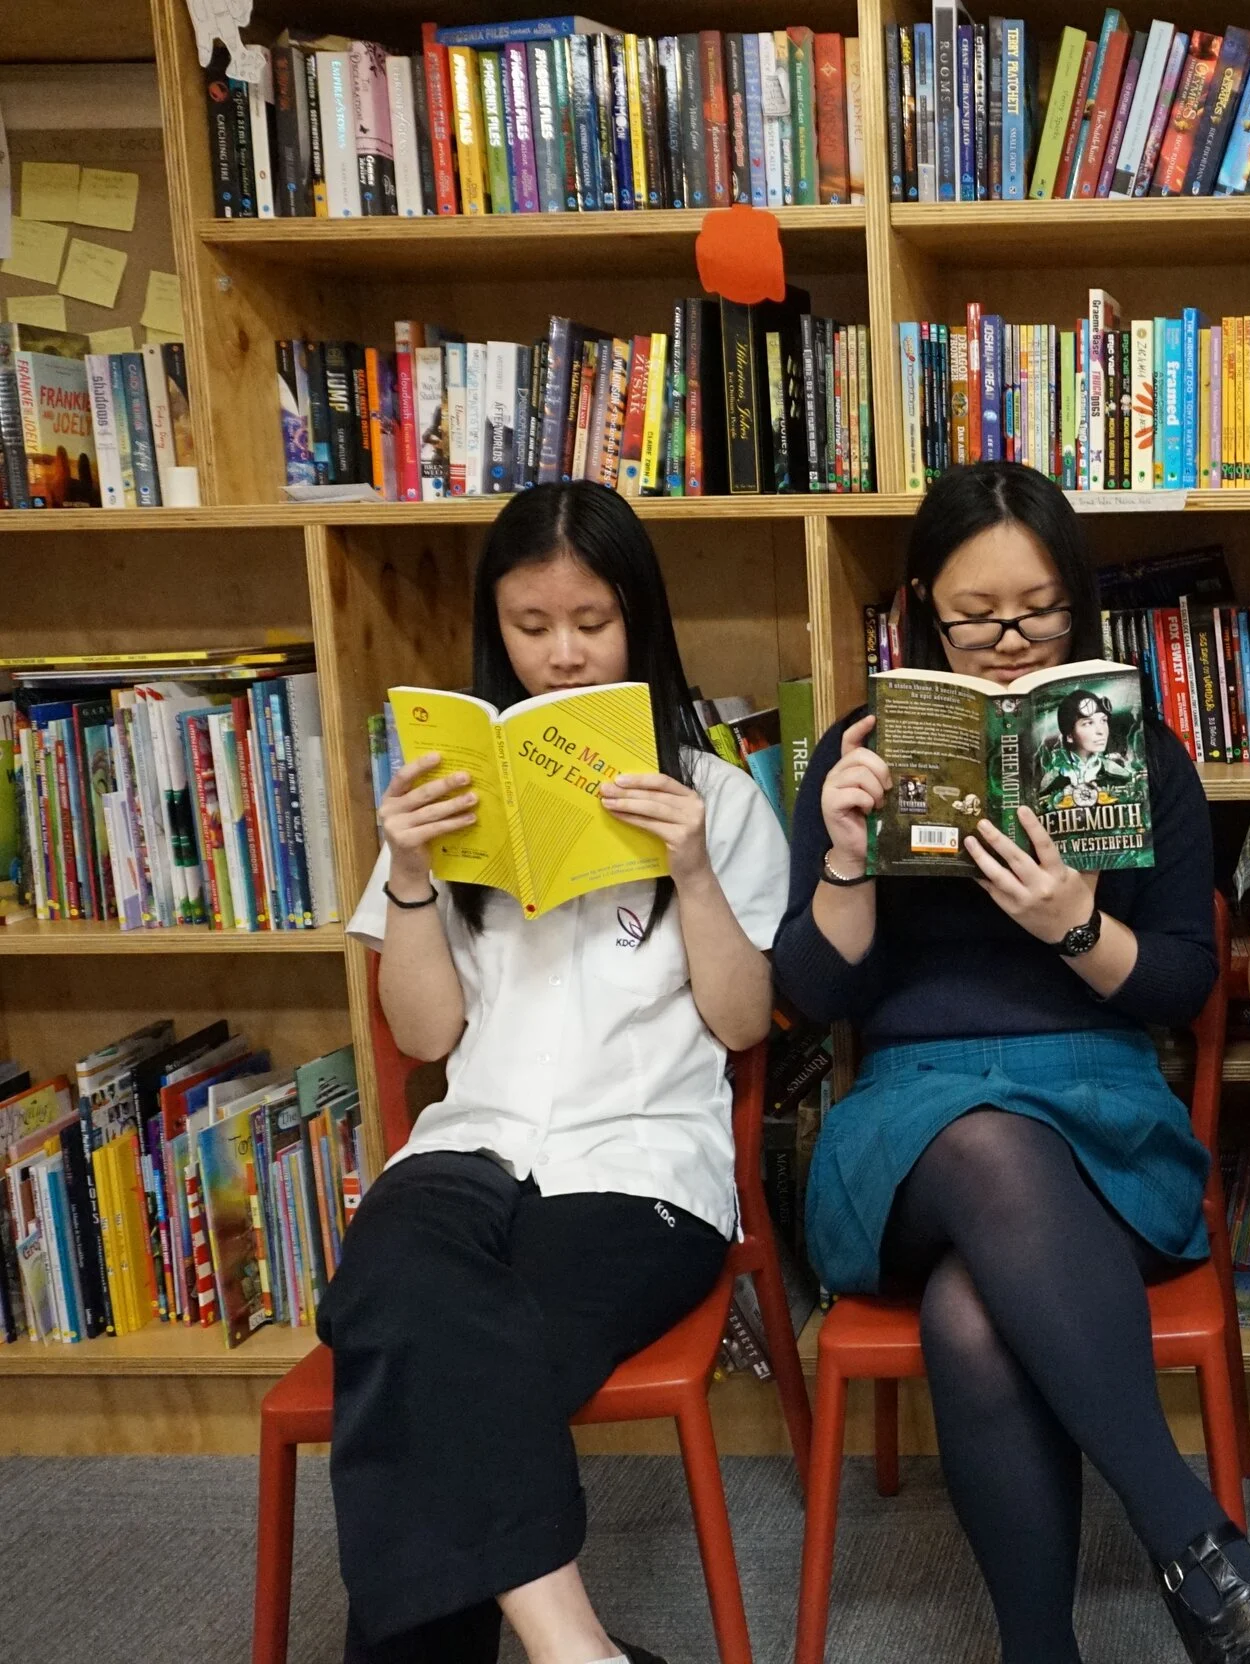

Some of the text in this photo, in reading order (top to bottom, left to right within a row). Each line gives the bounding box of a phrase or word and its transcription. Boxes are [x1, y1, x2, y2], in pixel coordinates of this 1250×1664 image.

[1008, 28, 1018, 57] TERRY
[483, 64, 500, 147] PHOENIX FILES
[536, 54, 553, 139] PHOENIX FILES
[1007, 61, 1019, 114] PRATCHETT
[217, 114, 229, 181] CATCHING FIRE
[1164, 153, 1178, 184] RIORDAN
[1196, 128, 1216, 179] RICK RIORDAN
[1092, 300, 1101, 355] Graeme Base
[958, 334, 967, 381] DRAGON
[17, 360, 38, 452] FRANKIE JOELY
[326, 371, 349, 413] JUMP
[629, 355, 645, 414] ZUSAK
[736, 342, 752, 440] Hilarious Jokes
[1166, 361, 1180, 425] framed
[493, 402, 505, 462] AFTERWORLDS
[1168, 617, 1184, 683] FOX SWIFT
[236, 742, 244, 770] HERMAN
[519, 740, 563, 777] Story
[543, 726, 621, 778] One Man
[1001, 735, 1019, 809] BEHEMOTH
[238, 773, 246, 787] AND
[248, 844, 258, 873] GORDON
[1072, 834, 1143, 852] WESTERFELD
[616, 938, 635, 947] KDC
[654, 1201, 676, 1227] KDC
